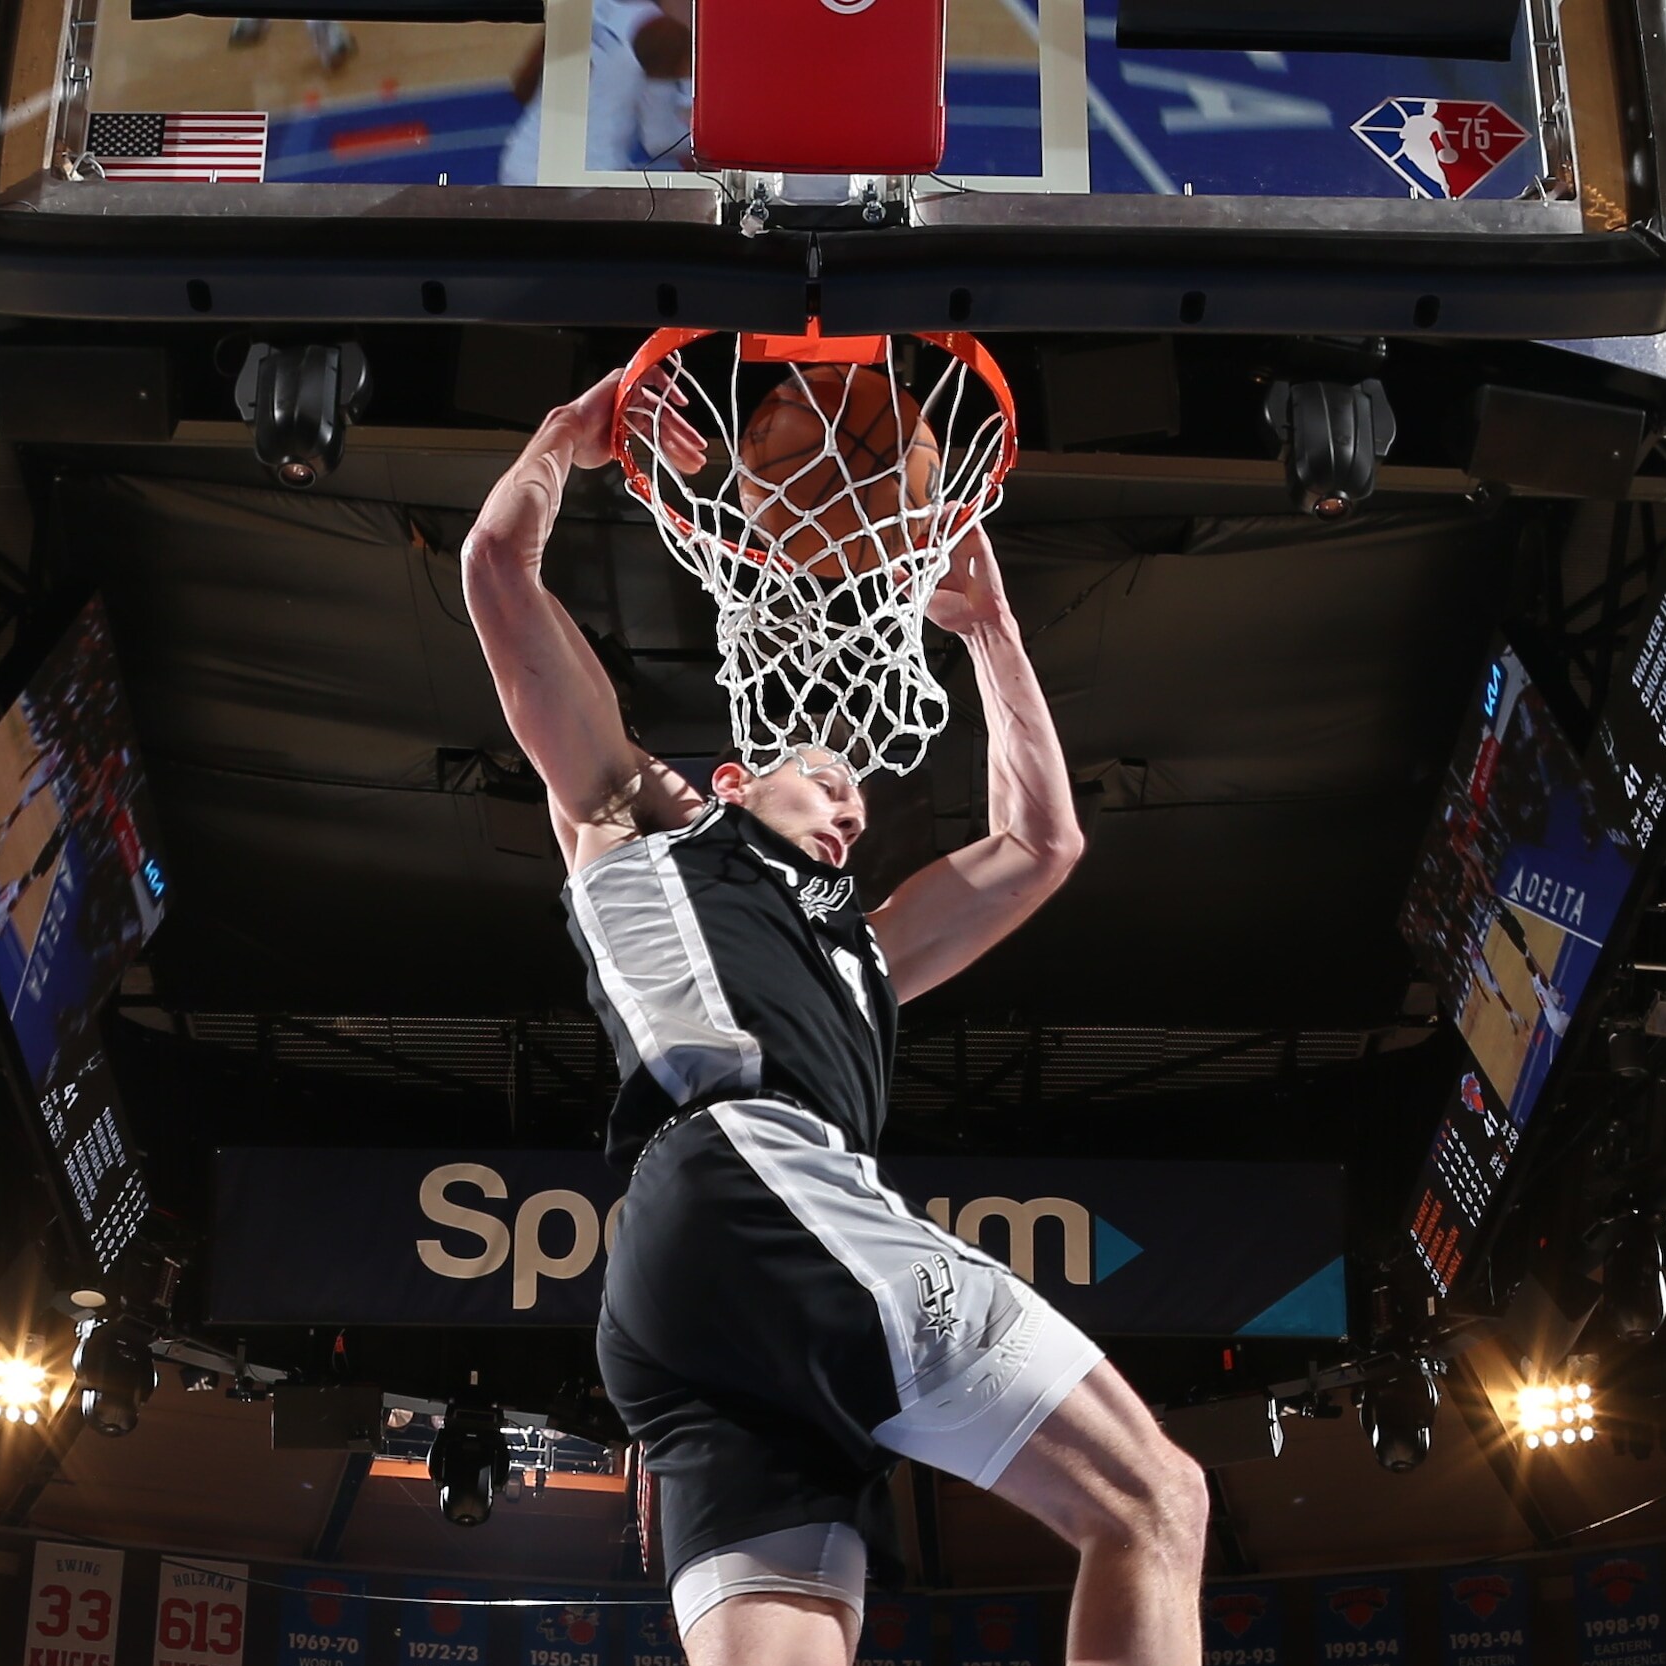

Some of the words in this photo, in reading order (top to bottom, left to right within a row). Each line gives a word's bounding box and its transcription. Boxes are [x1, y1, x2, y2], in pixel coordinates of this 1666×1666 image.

[1458, 117, 1490, 150] 75
[1525, 872, 1585, 927] DELTA
[56, 1559, 101, 1576] EWING
[172, 1573, 236, 1593] HOLZMAN
[36, 1585, 112, 1642] 33
[158, 1597, 242, 1655] 613
[1584, 1613, 1661, 1638] 1998-99
[287, 1631, 360, 1655] 1969-70
[1325, 1639, 1399, 1660] 1993-94
[1449, 1630, 1524, 1650] 1993-94
[1593, 1637, 1652, 1656] EASTERN
[408, 1641, 479, 1662] 1972-73
